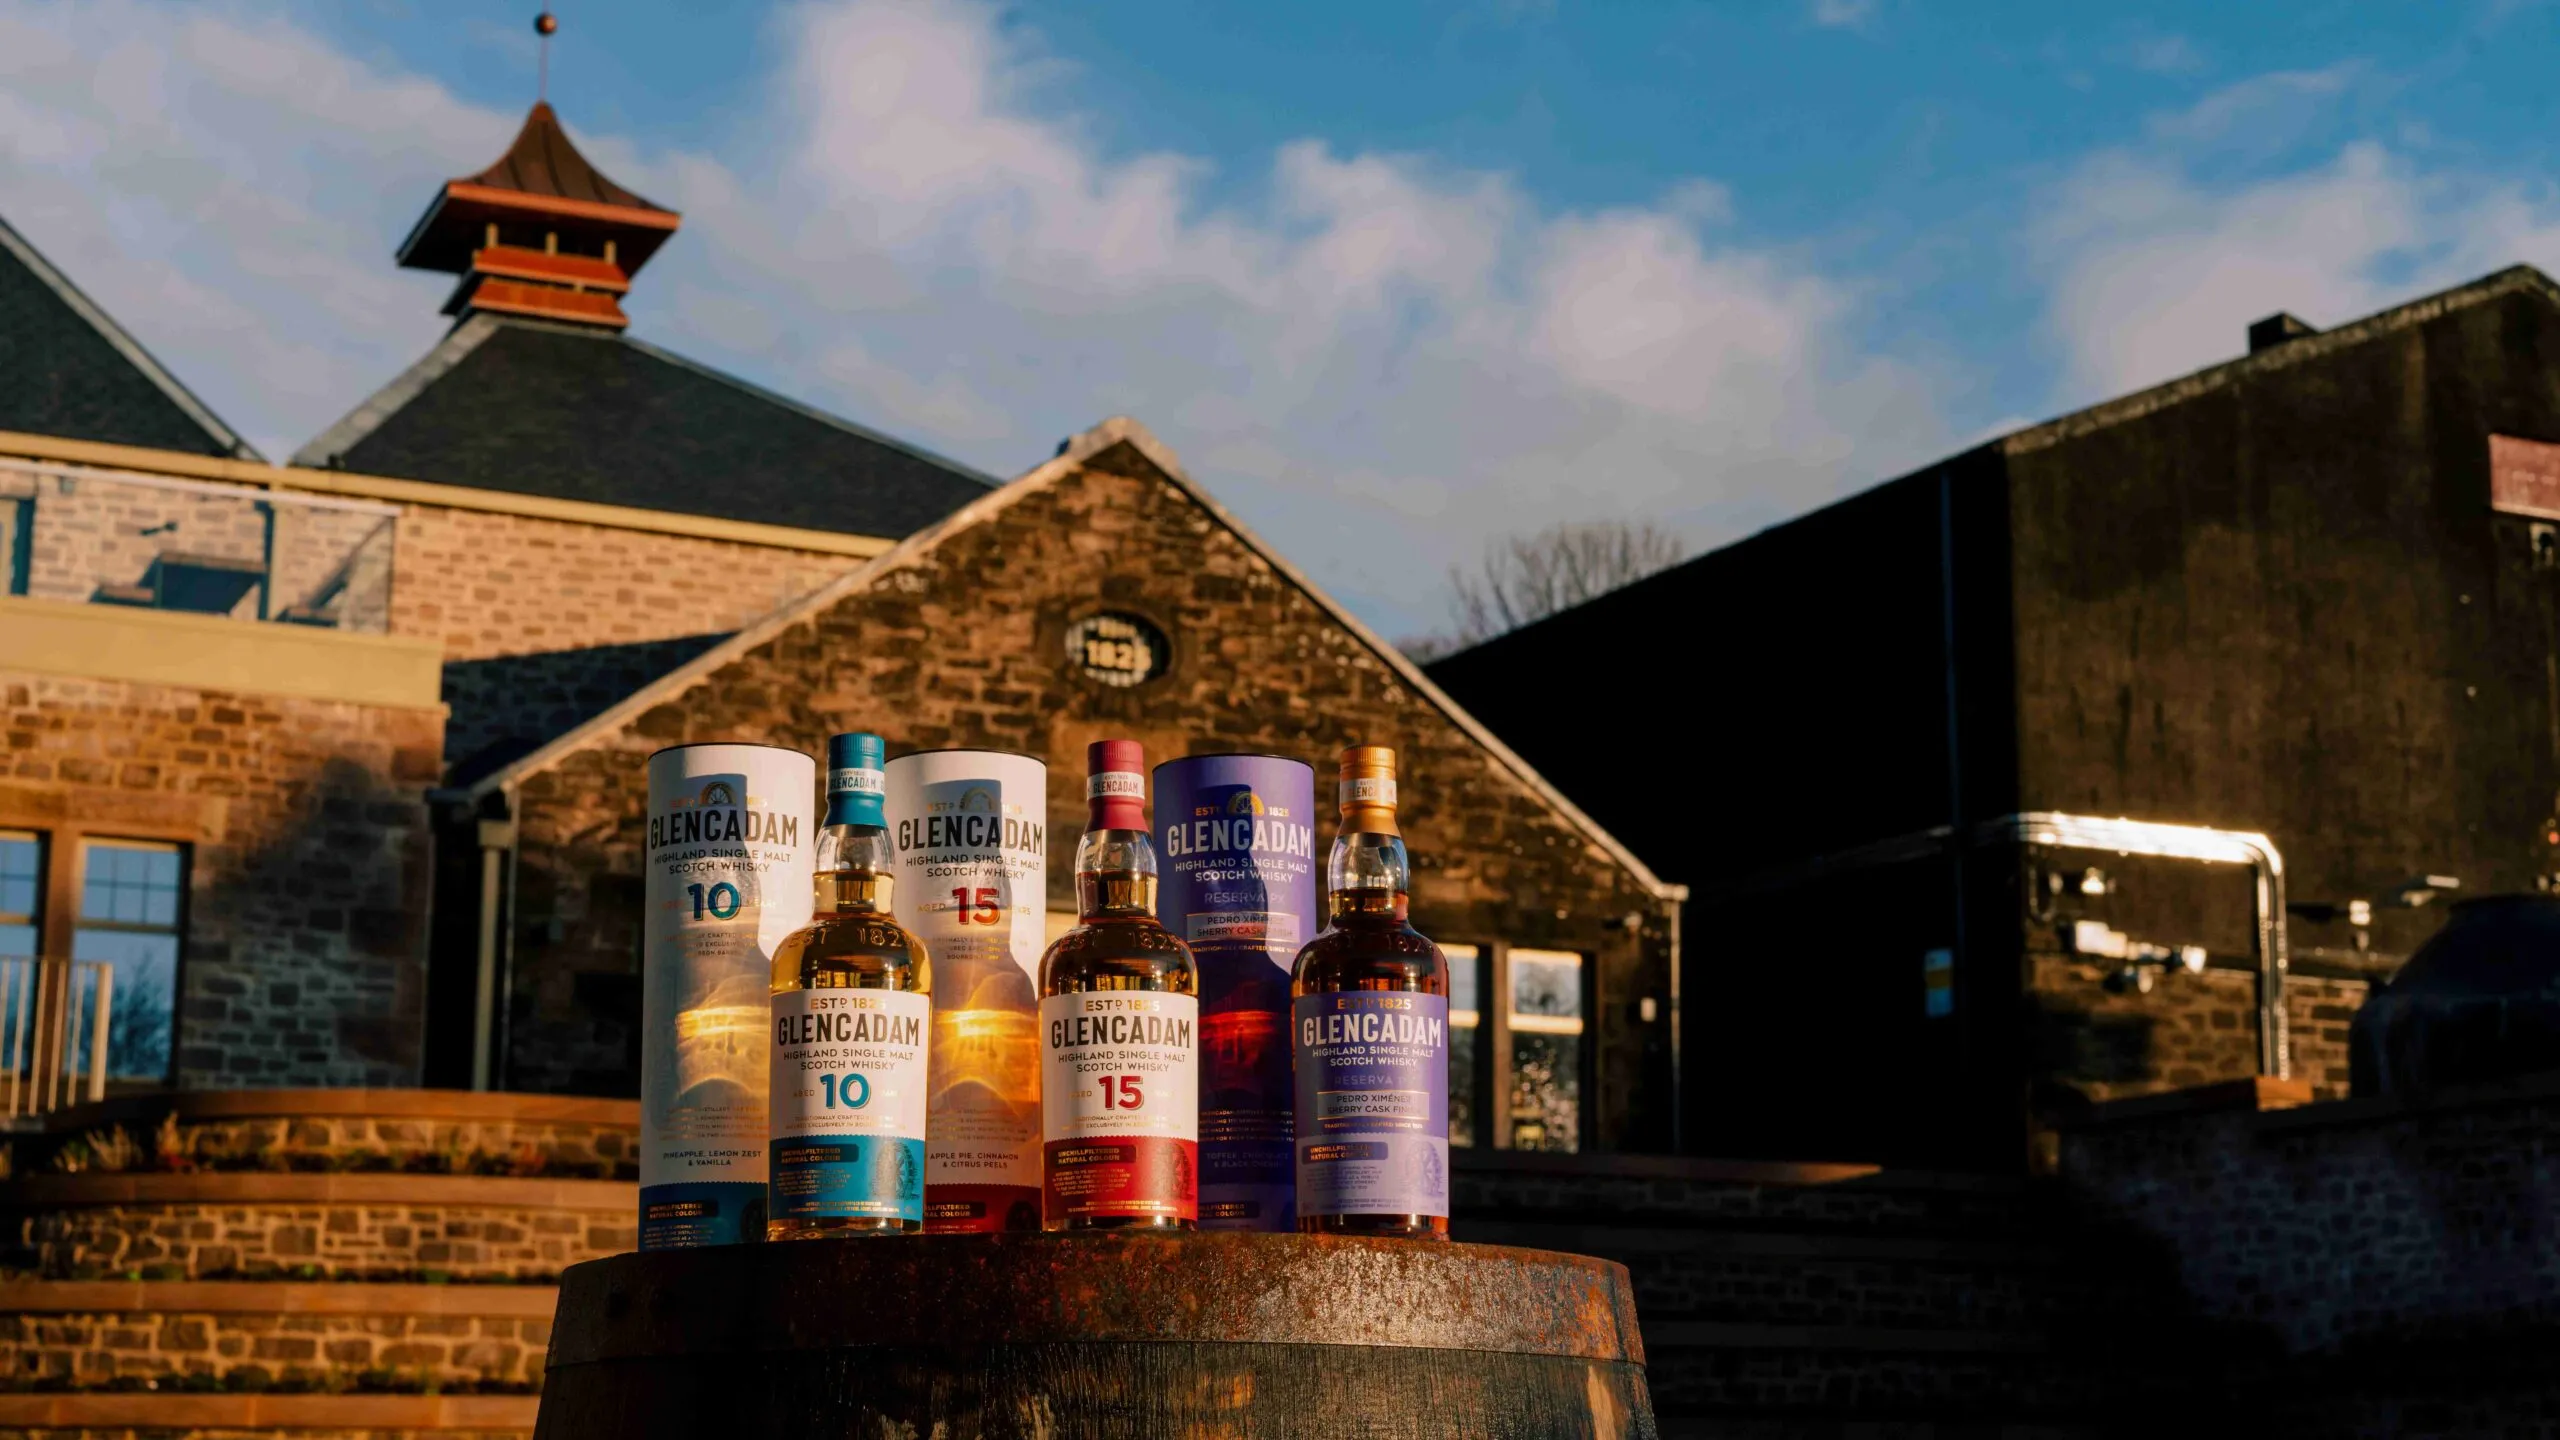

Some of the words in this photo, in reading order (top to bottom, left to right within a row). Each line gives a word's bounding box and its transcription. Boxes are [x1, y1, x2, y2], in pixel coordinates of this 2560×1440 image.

[1093, 781, 1138, 794] GLENCADAM
[651, 809, 798, 850] GLENCADAM
[899, 815, 1043, 857] GLENCADAM
[1167, 819, 1311, 860] GLENCADAM
[655, 850, 706, 865] HIGHLAND
[712, 849, 759, 859] SINGLE
[764, 852, 791, 863] MALT
[906, 854, 969, 867] HIGHLAND
[974, 854, 1016, 866] SINGLE
[1021, 861, 1040, 871] MALT
[669, 862, 715, 874] SCOTCH
[721, 862, 770, 873] WHISKY
[1175, 858, 1236, 872] HIGHLAND
[1241, 858, 1284, 870] SINGLE
[1288, 861, 1308, 874] MALT
[927, 867, 977, 878] SCOTCH
[983, 868, 1025, 879] WHISKY
[1195, 870, 1245, 882] SCOTCH
[1250, 871, 1293, 883] WHISKY
[687, 881, 742, 921] 10
[1204, 891, 1265, 904] RESERVA
[951, 887, 1000, 926] 15
[1207, 915, 1241, 925] PEDRO
[1197, 927, 1233, 937] SHERRY
[1237, 926, 1263, 936] CASK
[1378, 998, 1412, 1010] 1825
[778, 1012, 920, 1047] GLENCADAM
[1051, 1015, 1190, 1049] GLENCADAM
[1303, 1013, 1441, 1048] GLENCADAM
[783, 1048, 838, 1061] HIGHLAND
[843, 1048, 886, 1058] SINGLE
[889, 1051, 914, 1060] MALT
[1058, 1051, 1114, 1063] HIGHLAND
[1119, 1051, 1160, 1060] SINGLE
[1164, 1053, 1186, 1062] MALT
[1312, 1046, 1366, 1058] HIGHLAND
[1369, 1046, 1409, 1056] SINGLE
[1412, 1049, 1435, 1058] MALT
[800, 1060, 846, 1070] SCOTCH
[851, 1061, 896, 1070] WHISKY
[1076, 1062, 1122, 1072] SCOTCH
[1127, 1063, 1169, 1072] WHISKY
[1330, 1057, 1373, 1067] SCOTCH
[1377, 1057, 1418, 1067] WHISKY
[1334, 1074, 1394, 1086] RESERVA
[819, 1073, 872, 1109] 10
[1098, 1075, 1144, 1110] 15
[1336, 1094, 1369, 1103] PEDRO
[1327, 1105, 1363, 1113] SHERRY
[1365, 1105, 1390, 1113] CASK
[741, 1150, 762, 1158] ZEST
[1310, 1152, 1339, 1160] NATURAL
